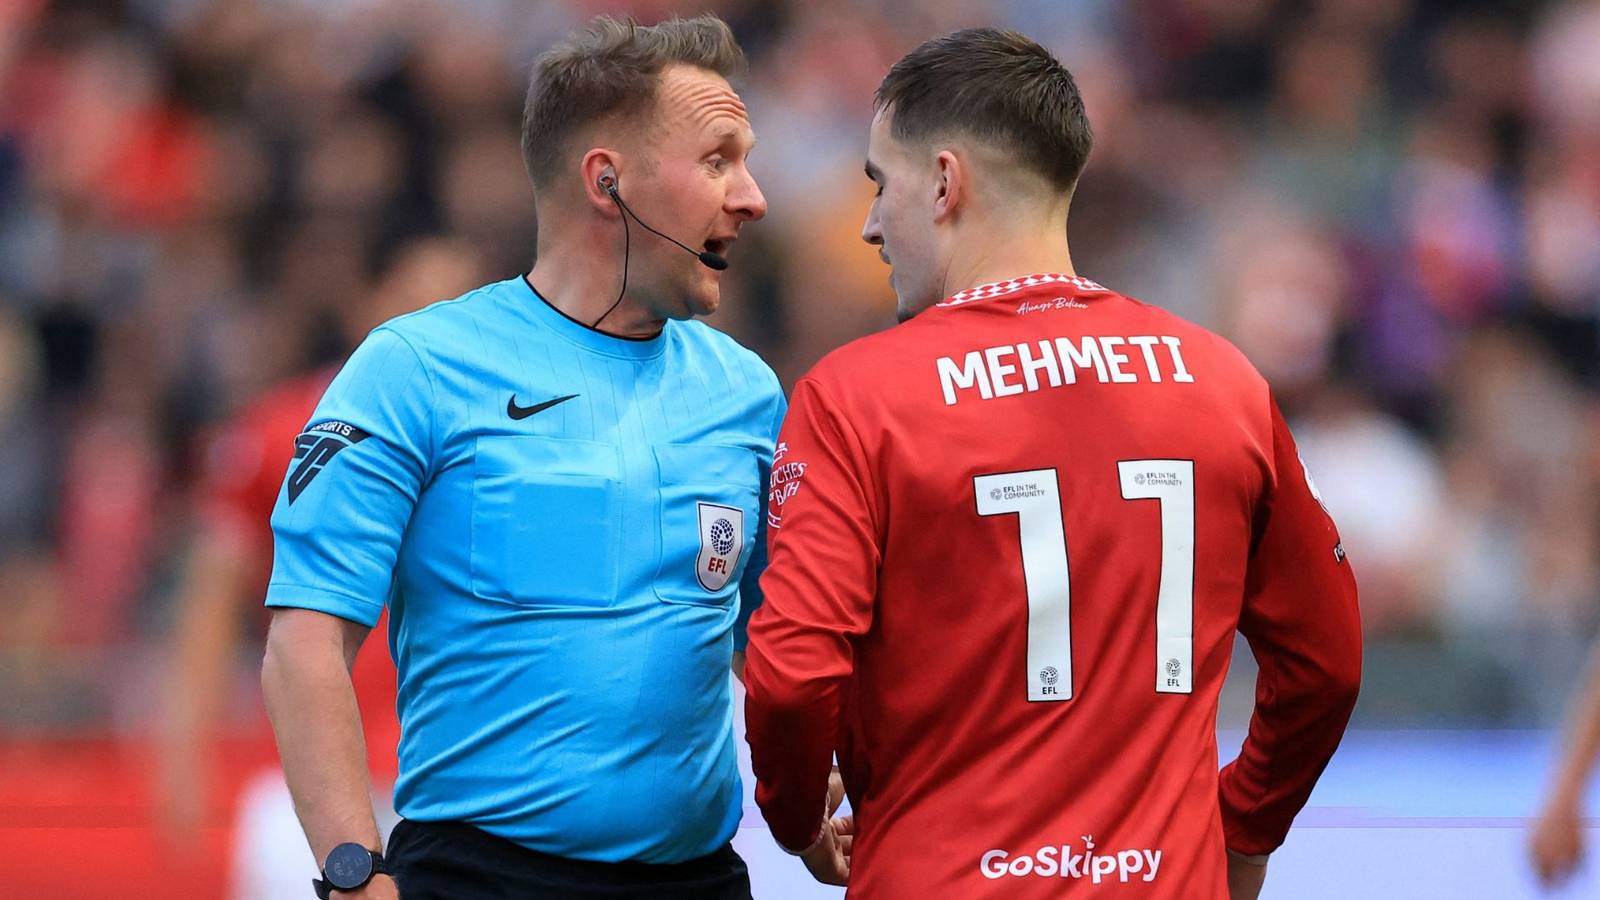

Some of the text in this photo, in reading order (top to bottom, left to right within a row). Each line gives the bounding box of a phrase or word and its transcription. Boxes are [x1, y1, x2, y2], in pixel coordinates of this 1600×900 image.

[936, 336, 1195, 406] MEHMETI
[1003, 489, 1045, 500] COMMUNITY
[708, 556, 727, 575] EFL
[1167, 678, 1180, 687] EFL
[1042, 686, 1058, 695] EFL
[980, 835, 1162, 884] GoSkippy
